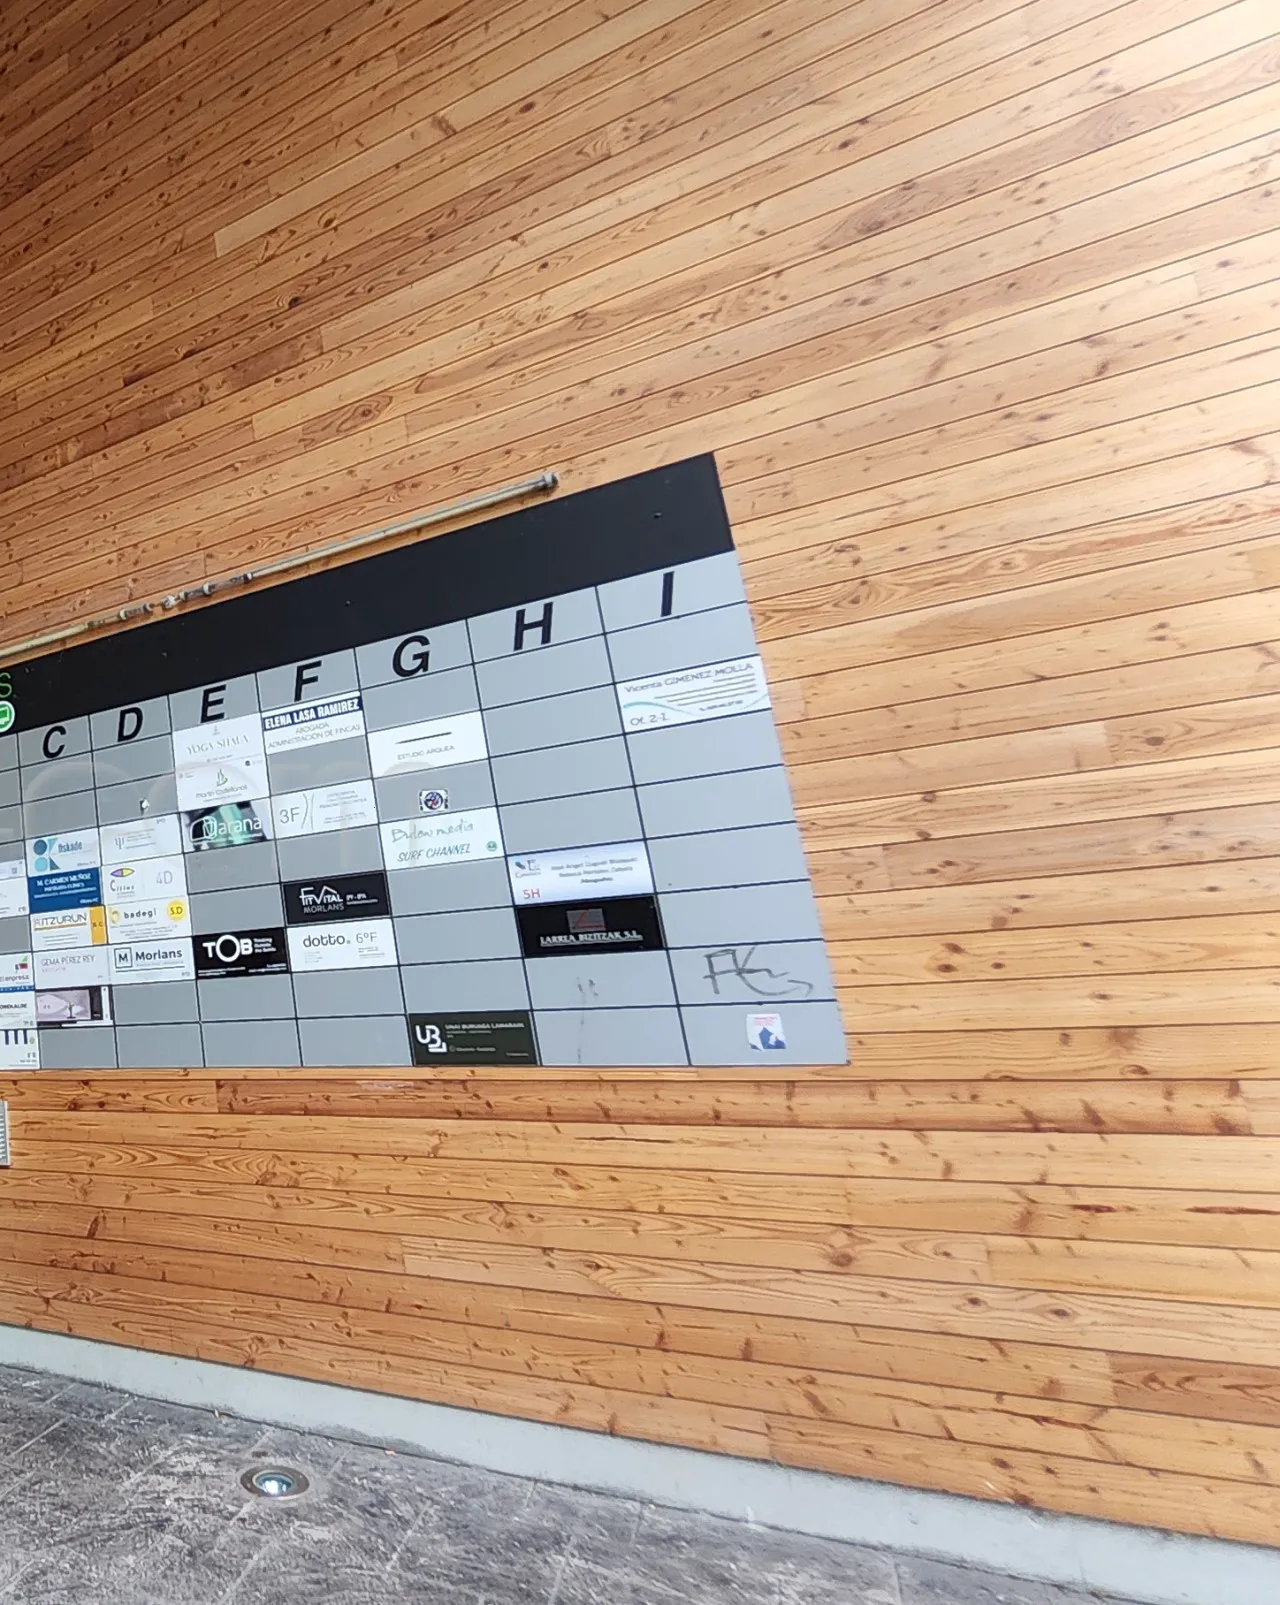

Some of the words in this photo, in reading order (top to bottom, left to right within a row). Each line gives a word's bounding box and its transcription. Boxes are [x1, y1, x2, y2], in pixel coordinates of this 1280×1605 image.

[42, 726, 67, 758] C
[117, 706, 144, 741] D
[200, 684, 228, 723] E
[295, 661, 322, 702] F
[392, 636, 430, 677] G
[513, 602, 554, 652] H
[661, 572, 675, 617] I
[264, 712, 293, 730] ELENA
[293, 707, 317, 724] LASA
[317, 698, 361, 719] RAMIREZ
[279, 806, 301, 825] 3F
[397, 848, 423, 863] SURF
[425, 842, 472, 859] CHANNEL
[523, 888, 541, 900] 5H
[124, 907, 157, 919] badegi
[303, 903, 345, 915] MORLANS
[202, 934, 254, 963] TOB
[539, 934, 576, 946] LARREA
[118, 952, 129, 963] M
[135, 948, 183, 961] Morlans
